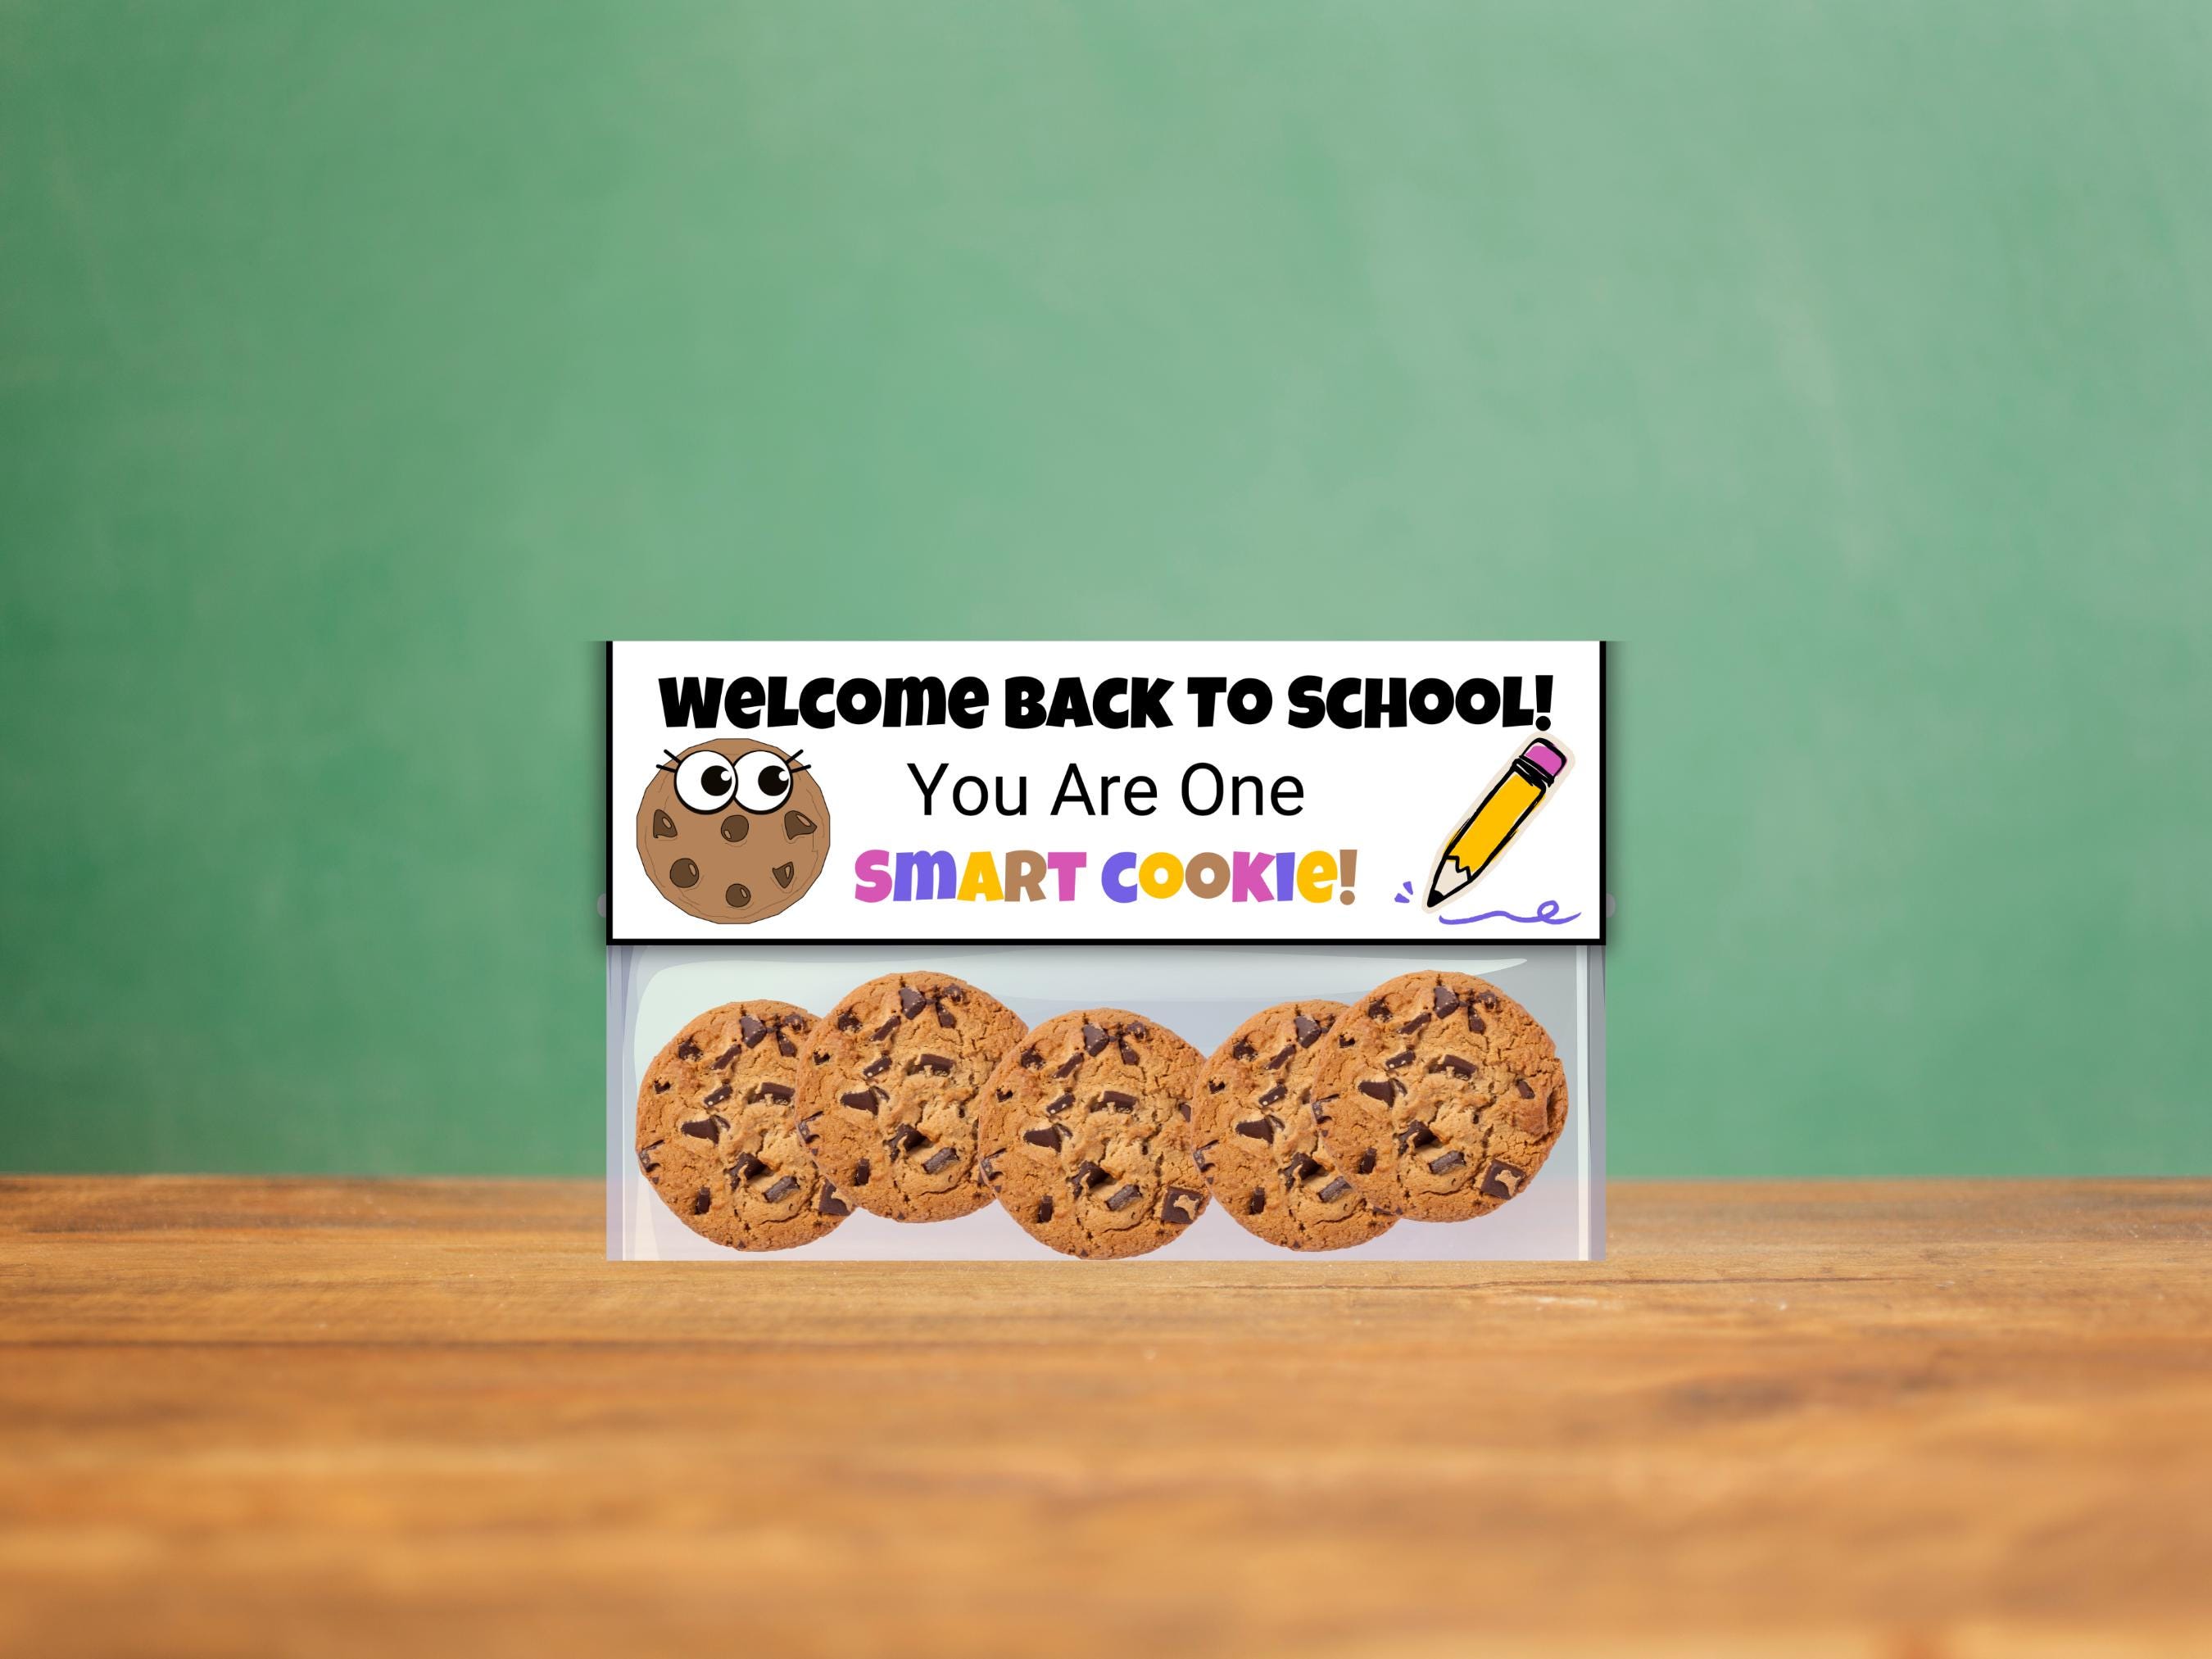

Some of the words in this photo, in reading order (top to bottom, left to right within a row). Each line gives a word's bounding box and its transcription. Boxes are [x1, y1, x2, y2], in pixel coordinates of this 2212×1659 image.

[1005, 676, 1174, 729] BACK
[1187, 677, 1272, 728] TO
[1288, 675, 1553, 732] SCHOOL!
[907, 764, 1027, 816] You
[1050, 764, 1157, 816] Are
[1181, 763, 1303, 816] One
